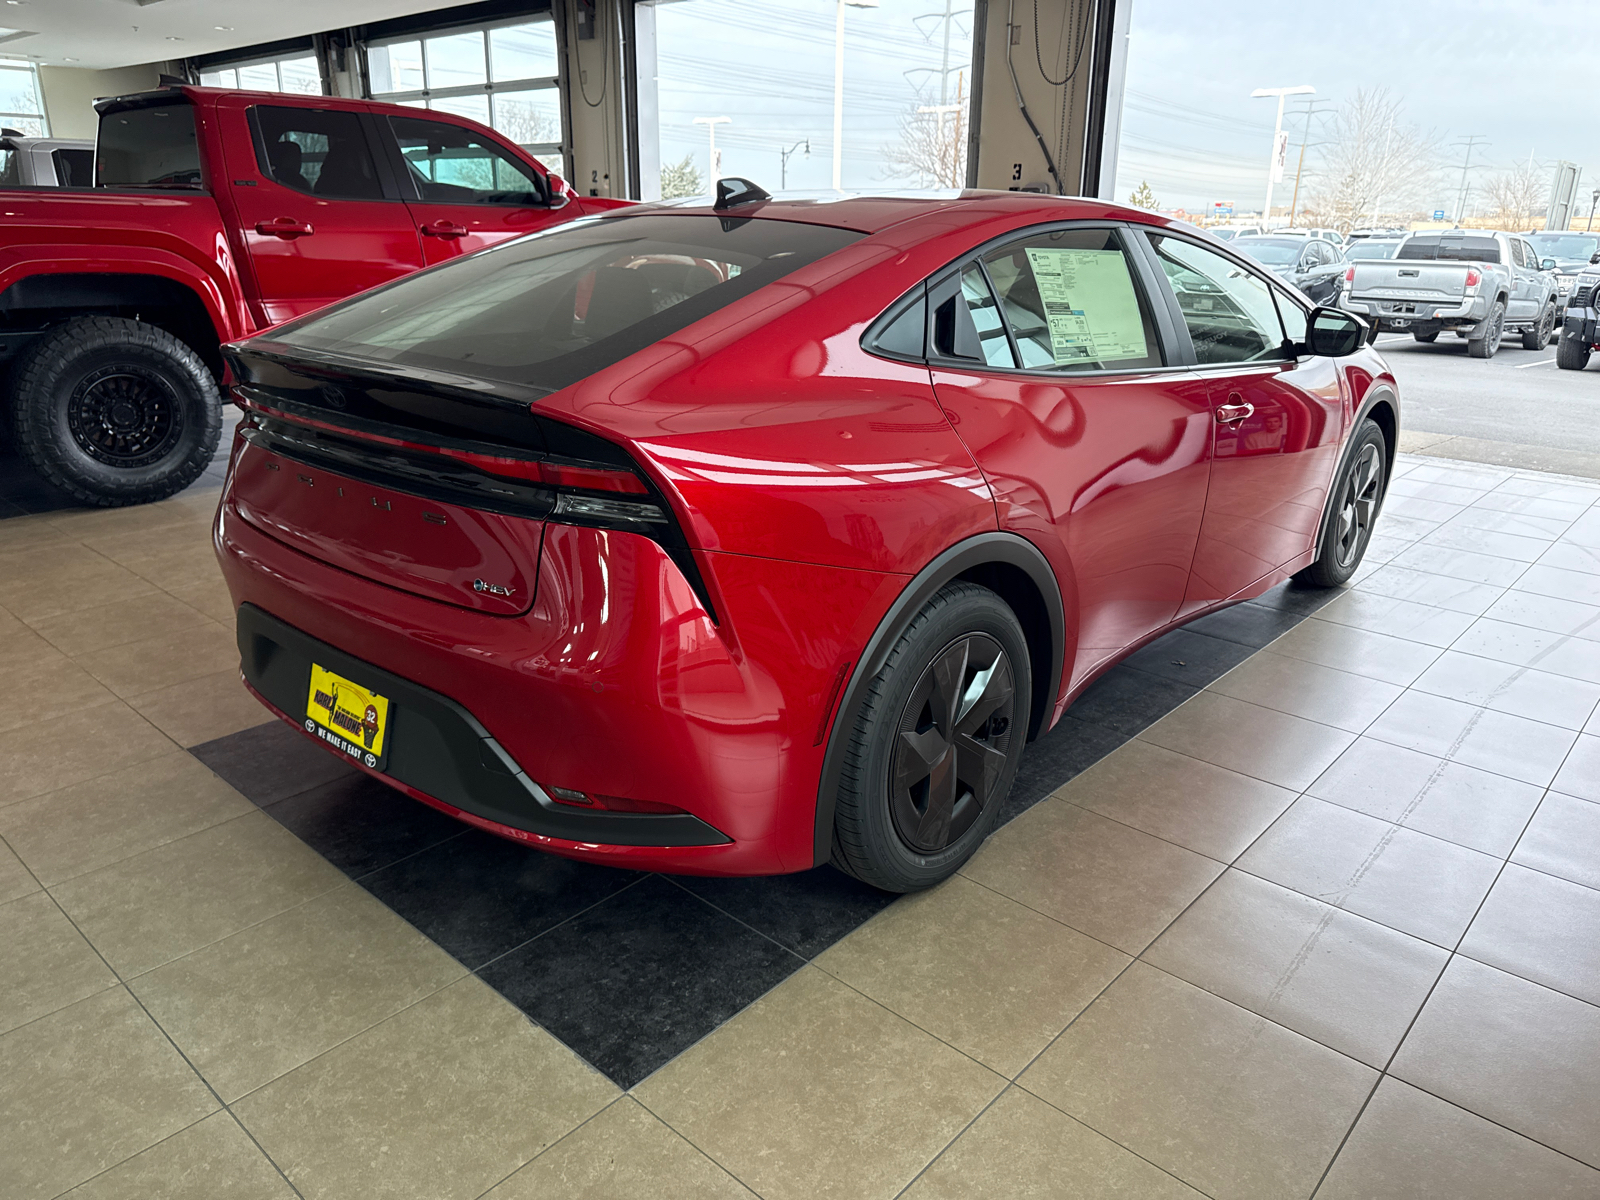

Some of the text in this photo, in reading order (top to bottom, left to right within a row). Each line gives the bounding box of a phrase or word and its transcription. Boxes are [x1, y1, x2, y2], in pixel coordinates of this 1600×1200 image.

[592, 170, 598, 183] 2
[1012, 163, 1022, 180] 3
[1374, 289, 1441, 298] TACOMA
[265, 462, 446, 525] PRIUS
[482, 582, 516, 597] HEV
[332, 709, 362, 737] MALONE
[366, 710, 376, 724] 32
[318, 727, 362, 759] WE MAKE IT EASY
